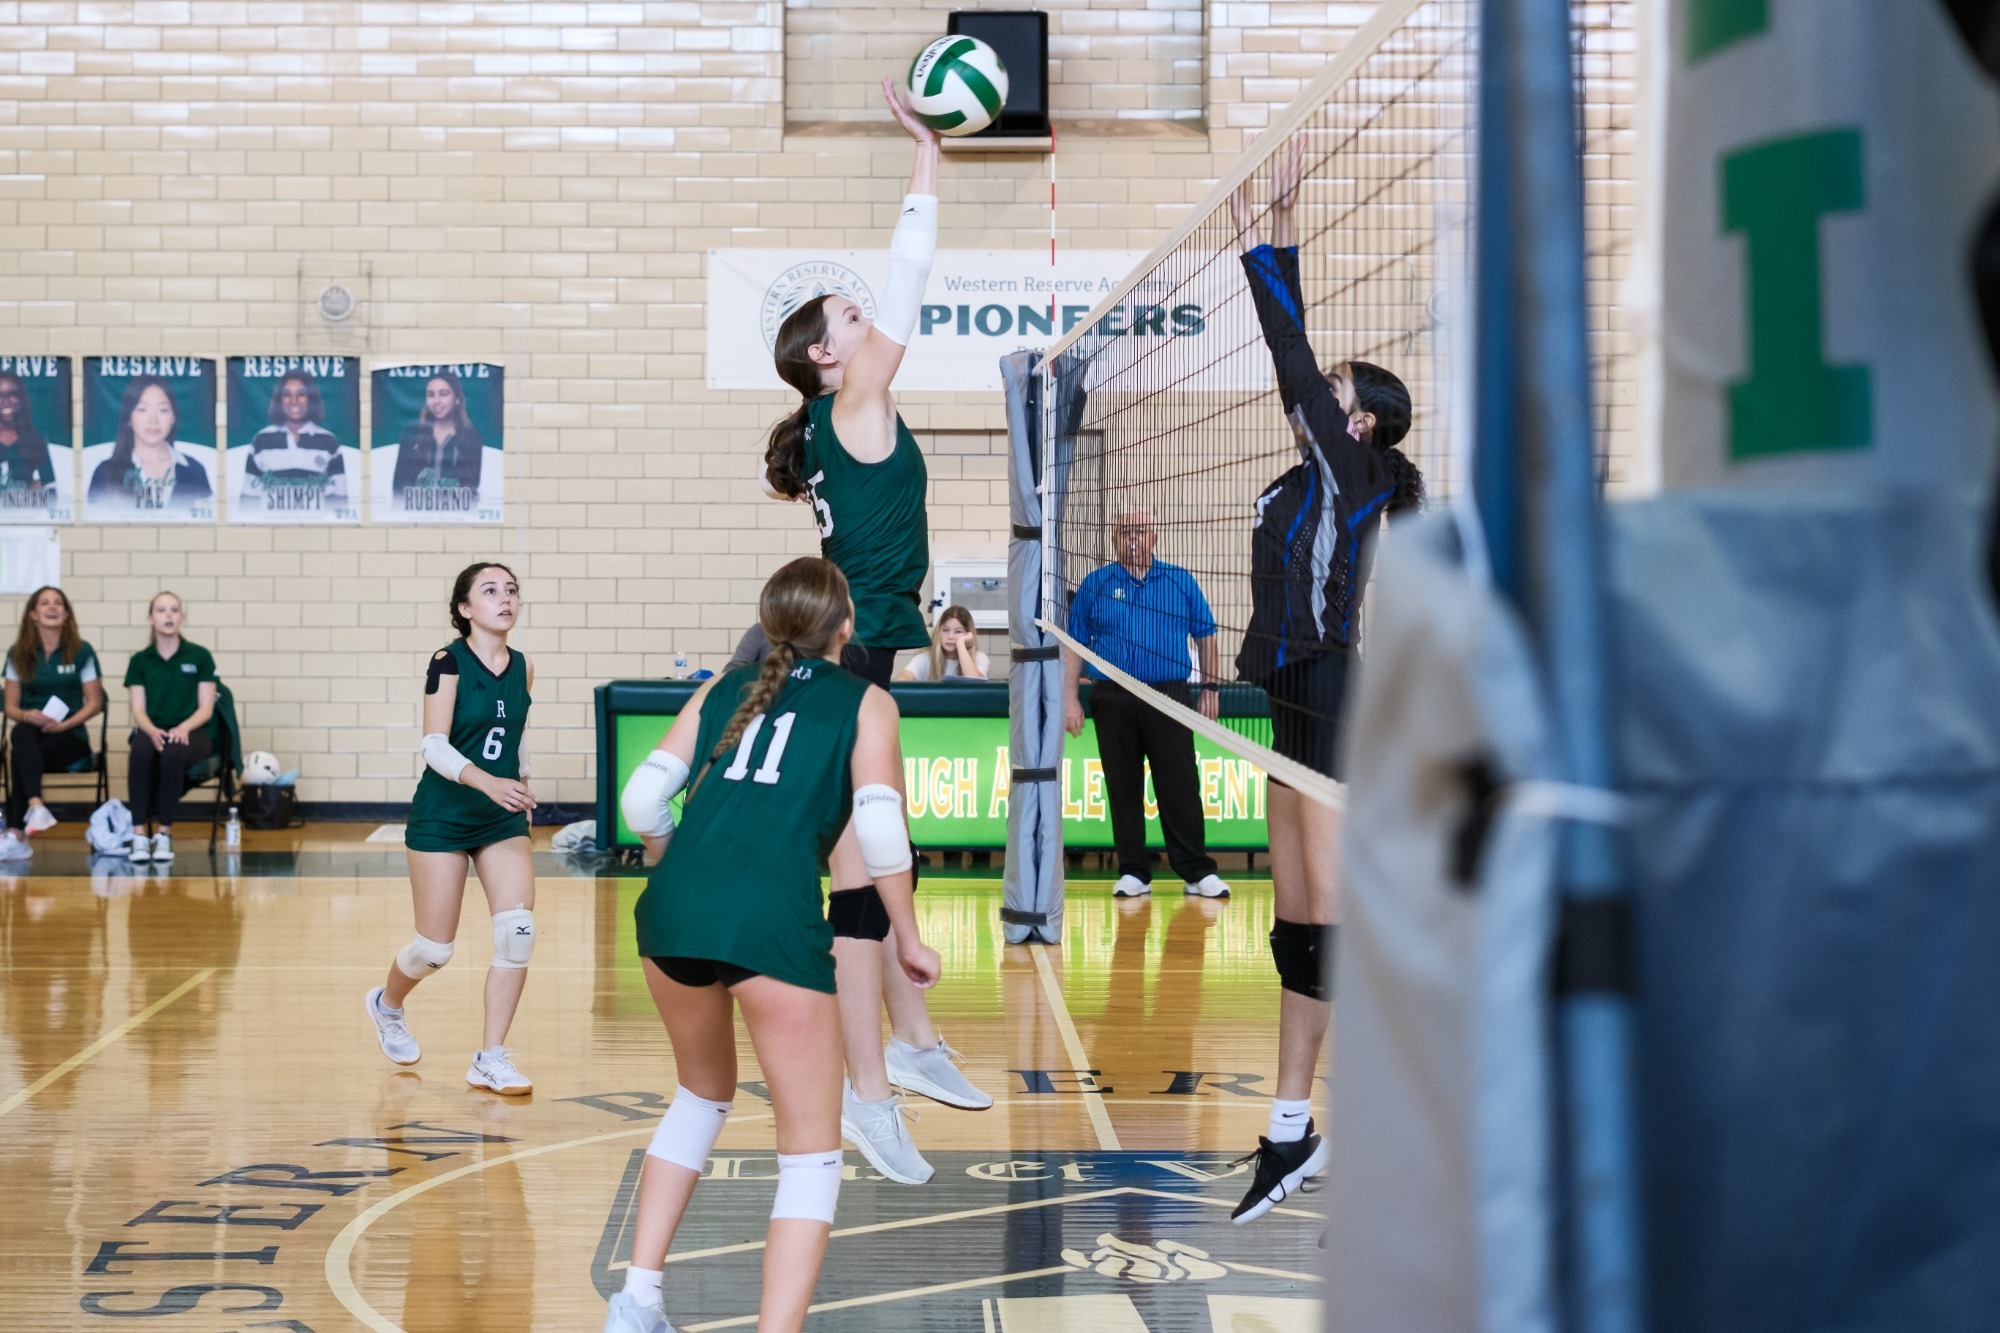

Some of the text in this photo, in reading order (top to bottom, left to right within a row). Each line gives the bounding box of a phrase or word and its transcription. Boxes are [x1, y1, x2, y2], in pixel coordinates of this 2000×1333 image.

[1686, 0, 1876, 469] I
[787, 264, 847, 283] RESERVE
[849, 279, 874, 317] ACAD
[944, 276, 1017, 292] Western
[1024, 276, 1093, 292] Reserve
[919, 303, 1206, 337] PIONEERS
[1, 357, 58, 377] ERVE
[100, 356, 201, 377] RESERVE
[244, 356, 345, 377] RESERVE
[404, 487, 471, 511] RUBIANO
[496, 700, 507, 718] R
[482, 727, 506, 761] 6
[723, 711, 797, 785] 11
[904, 757, 978, 818] UGH
